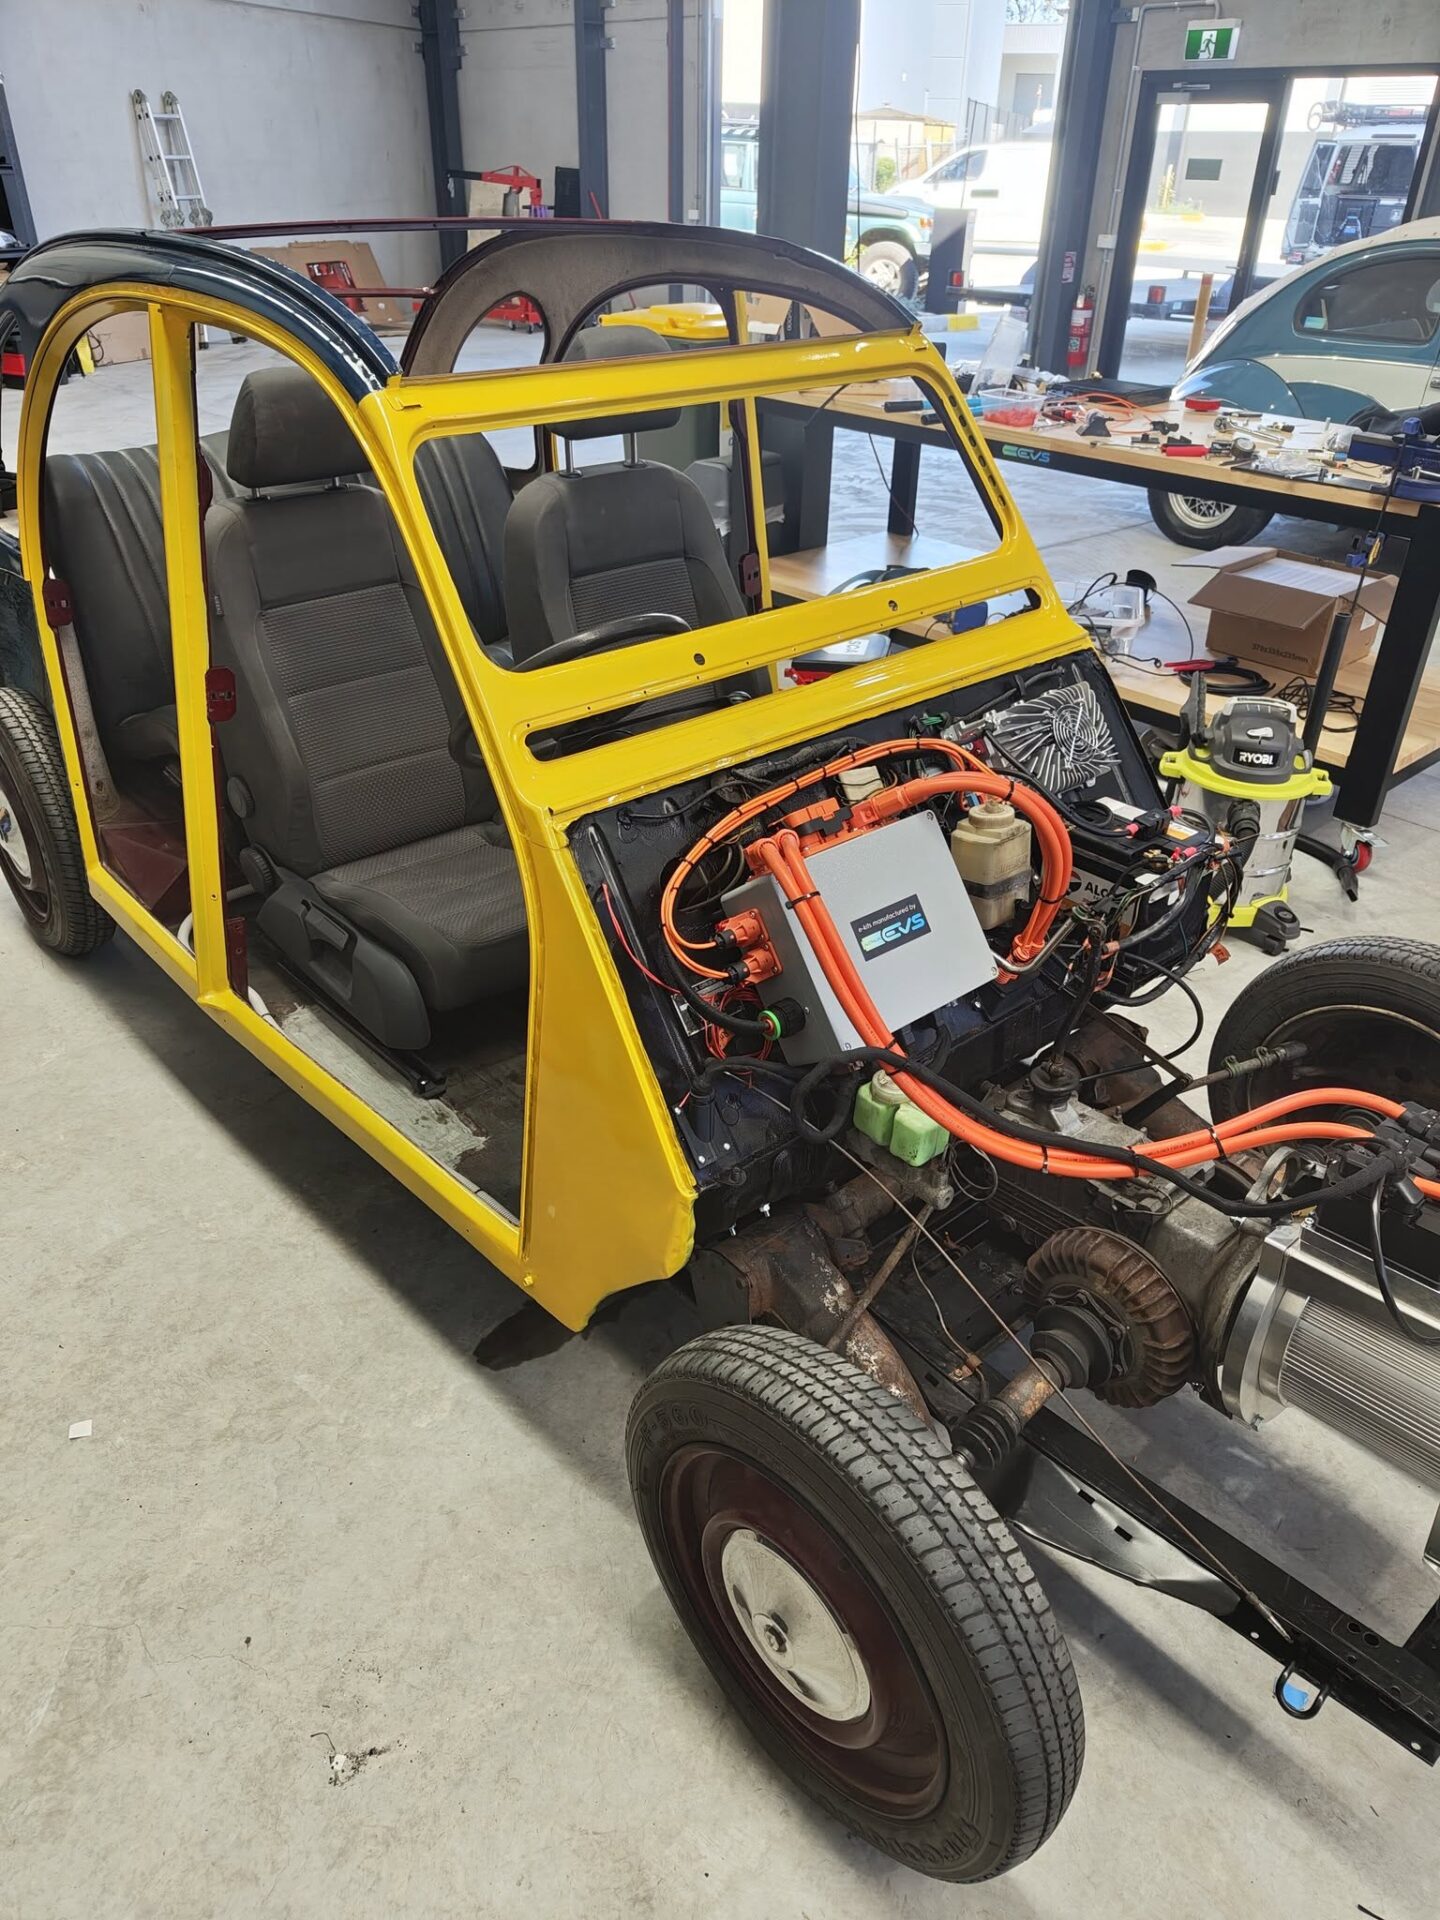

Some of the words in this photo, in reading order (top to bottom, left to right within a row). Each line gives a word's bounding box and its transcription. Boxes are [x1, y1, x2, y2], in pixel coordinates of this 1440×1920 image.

[1239, 751, 1274, 765] RYOBI
[872, 905, 909, 927] manufactured
[909, 903, 916, 912] by
